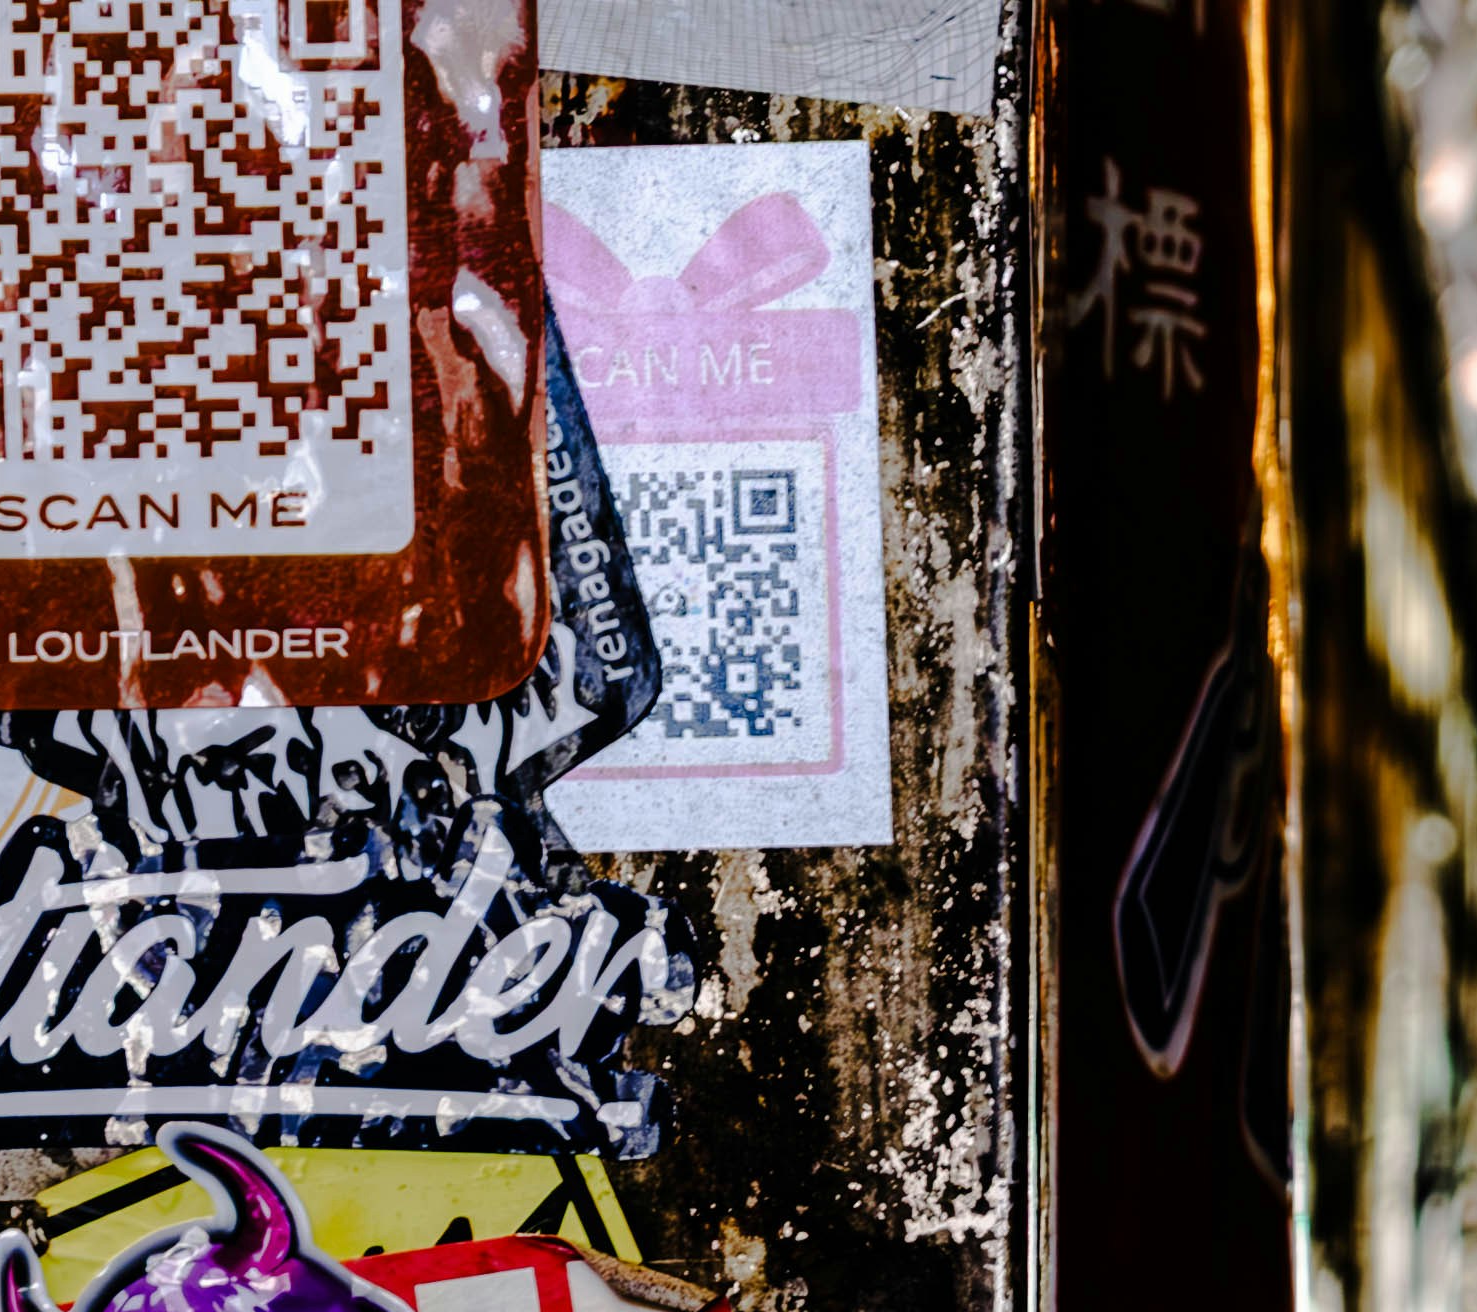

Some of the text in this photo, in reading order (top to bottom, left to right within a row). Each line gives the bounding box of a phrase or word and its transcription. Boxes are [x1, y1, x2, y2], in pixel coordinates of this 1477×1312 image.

[574, 342, 774, 389] CAN ME
[210, 491, 310, 529] ME
[8, 627, 349, 663] LOUTLANDER
